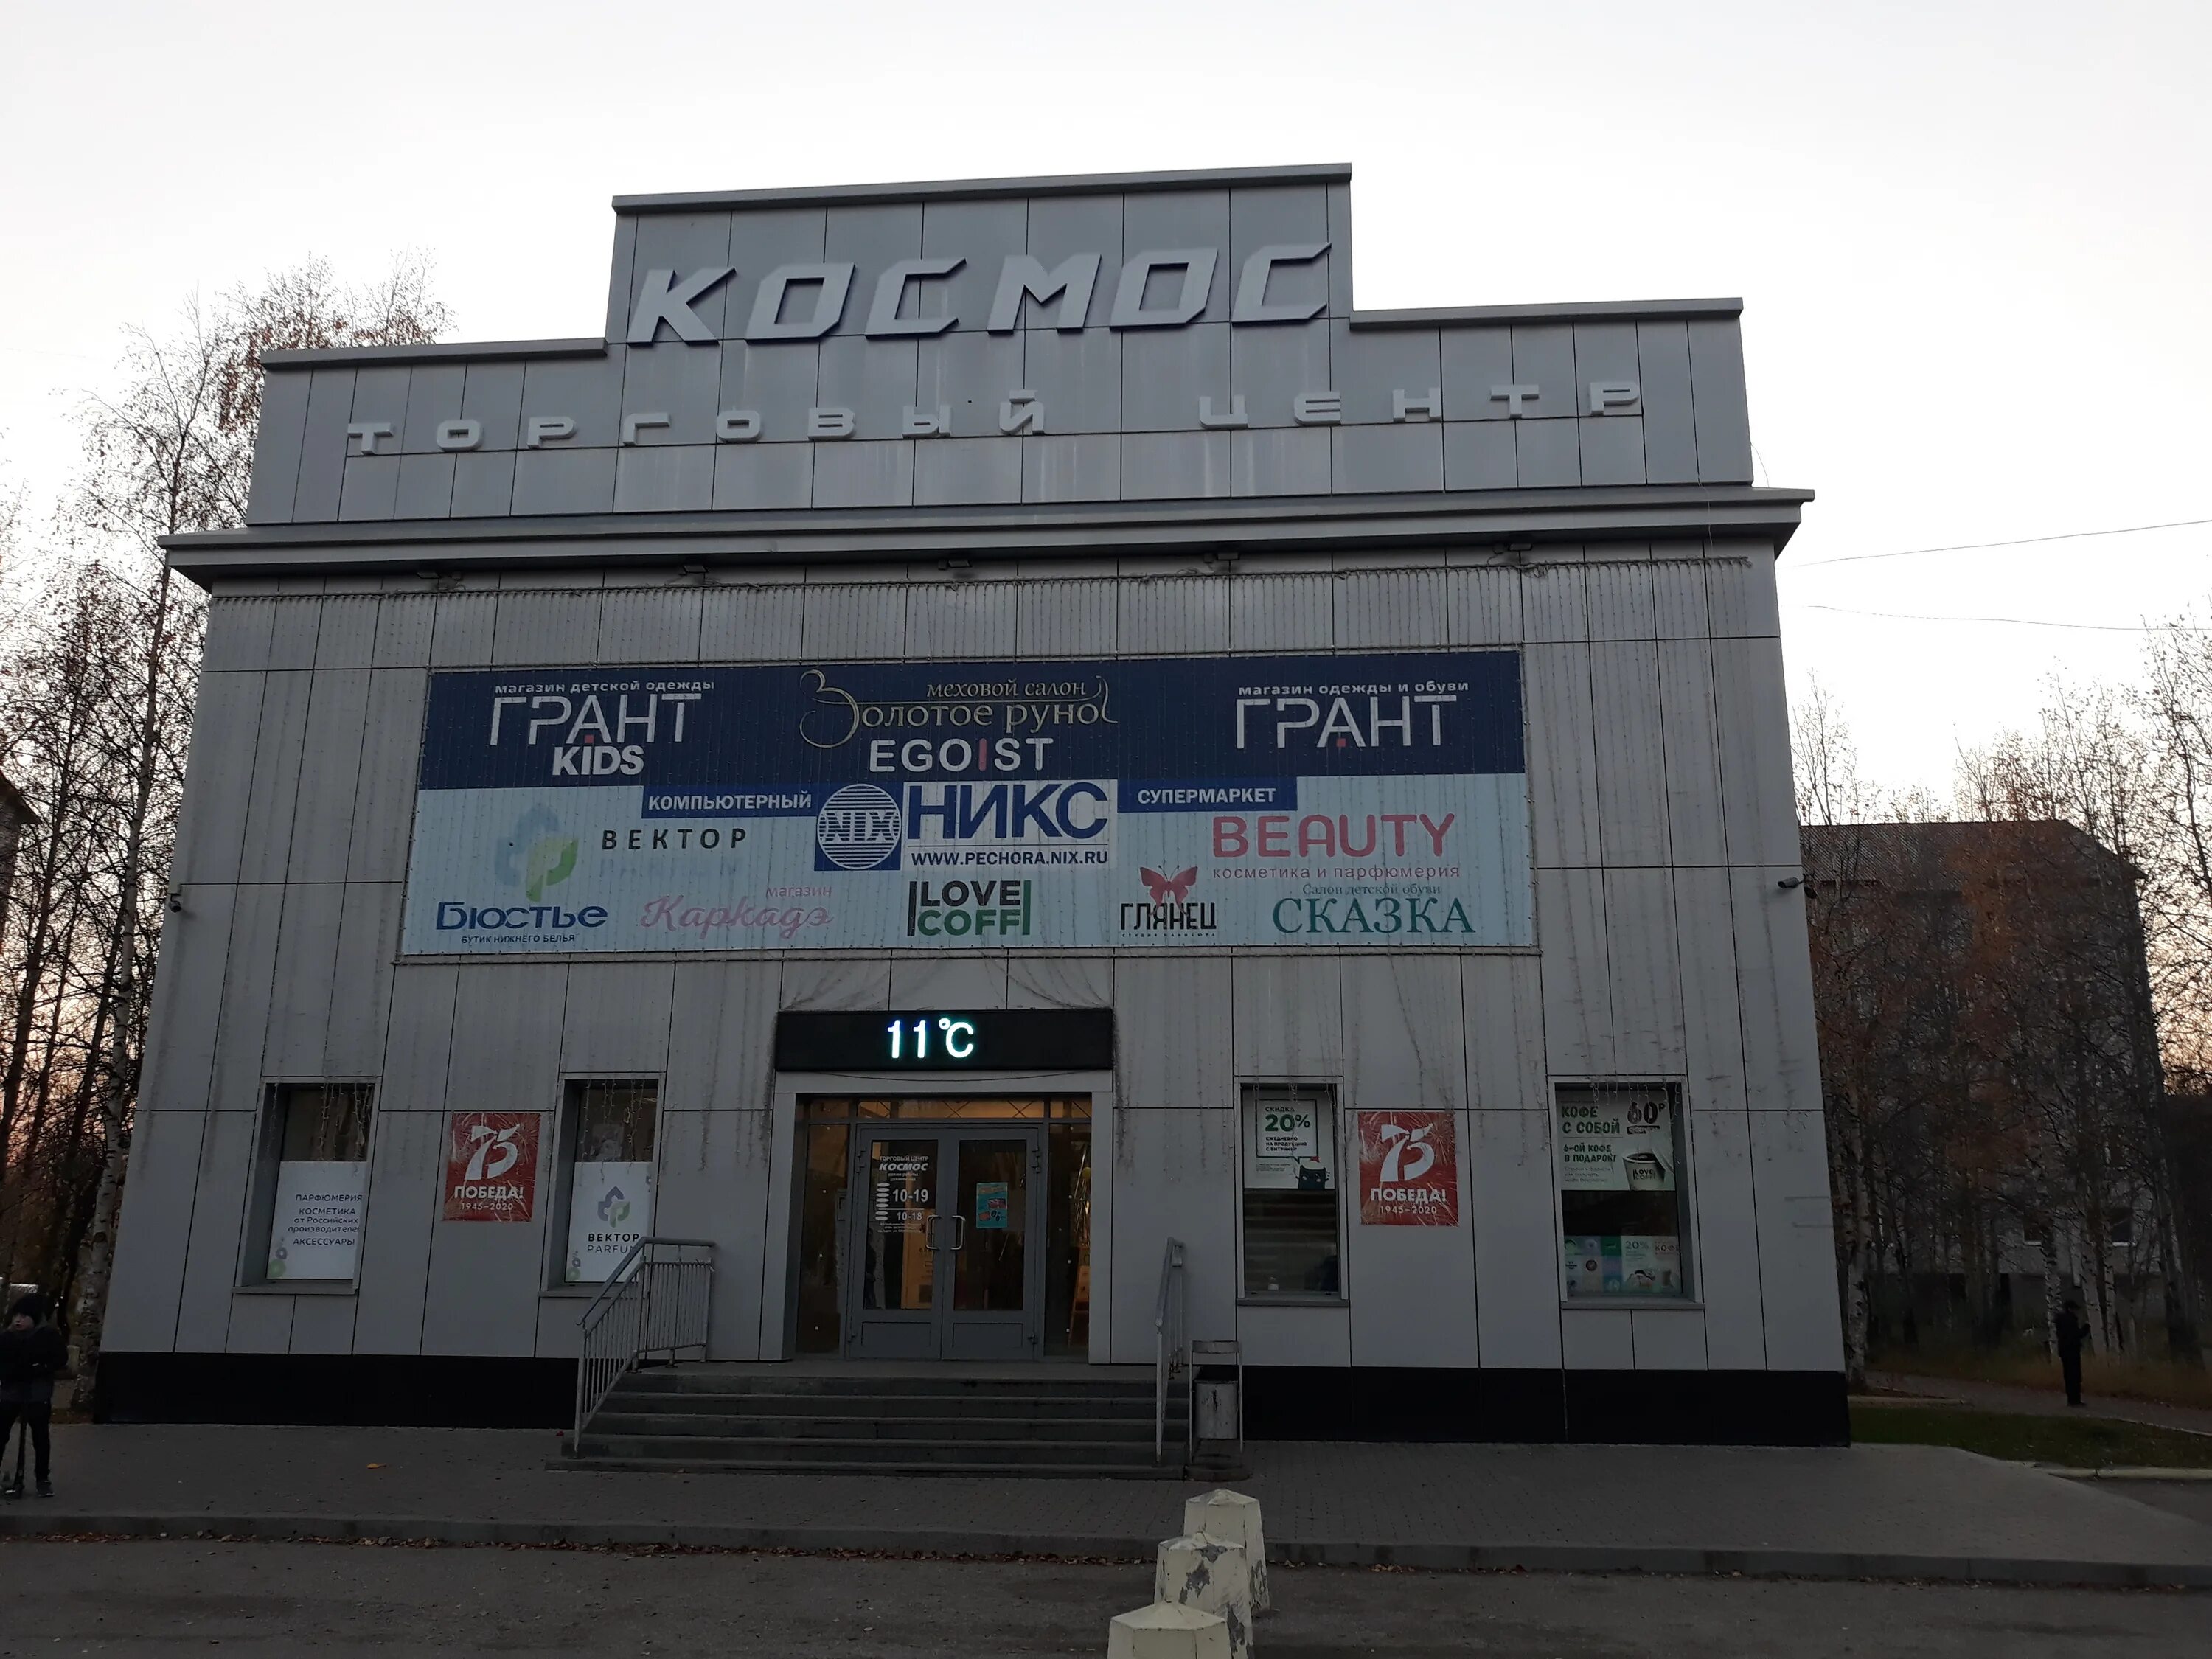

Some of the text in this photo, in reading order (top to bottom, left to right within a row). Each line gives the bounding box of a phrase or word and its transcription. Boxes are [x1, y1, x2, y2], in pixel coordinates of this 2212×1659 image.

[626, 243, 1331, 345] КОСМОС
[347, 381, 1642, 456] ТОРГОВЫЙ ЦЕНТР
[495, 680, 714, 694] магазин детской одежды
[926, 678, 1086, 698] меховой салон
[1238, 681, 1469, 695] магазин одежды и обуви
[799, 669, 1102, 748] Золотое руно
[490, 693, 702, 745] ГРАНТ
[1236, 695, 1457, 748] ГРАНТ
[552, 745, 644, 776] KIDS
[869, 738, 1054, 773] EGOIST
[648, 790, 812, 810] КОМПЬЮТЕРНЫЙ
[1138, 787, 1276, 804] СУПЕРМАРКЕТ
[907, 782, 1108, 840] НИКС
[825, 810, 894, 841] NIX
[602, 828, 746, 850] ВЕКТОР
[1213, 813, 1455, 858] BEAUTY
[911, 850, 1108, 866] WWW.PECHORA.NIX.RU
[1213, 864, 1460, 881] косметика и парфюмерия
[766, 886, 832, 897] магазин
[1302, 883, 1441, 896] Салон детской обуви
[641, 894, 834, 939] Каркадэ
[1121, 902, 1217, 931] ГЛЯНЕЦ
[1273, 897, 1476, 934] СКАЗКА
[462, 934, 575, 944] БУТИК НИЖНЕГО БЕЛЬЯ
[1562, 1106, 1599, 1118] КОФЕ
[1265, 1113, 1311, 1132] 20%
[1562, 1121, 1571, 1134] С
[1576, 1118, 1621, 1134] СОБОЙ
[1588, 1144, 1613, 1152] КОФЕ
[878, 1163, 929, 1171] КОСМОС
[1564, 1155, 1570, 1163] В
[295, 1194, 363, 1202] ПАРФЮМЕРИЯ
[453, 1186, 524, 1201] ПОБЕДА!
[892, 1189, 929, 1203] 10-19
[1370, 1188, 1447, 1204] ПОБЕДА!
[307, 1216, 359, 1224] Российских
[897, 1211, 922, 1221] 10-18
[588, 1233, 639, 1242] ВЕКТОР
